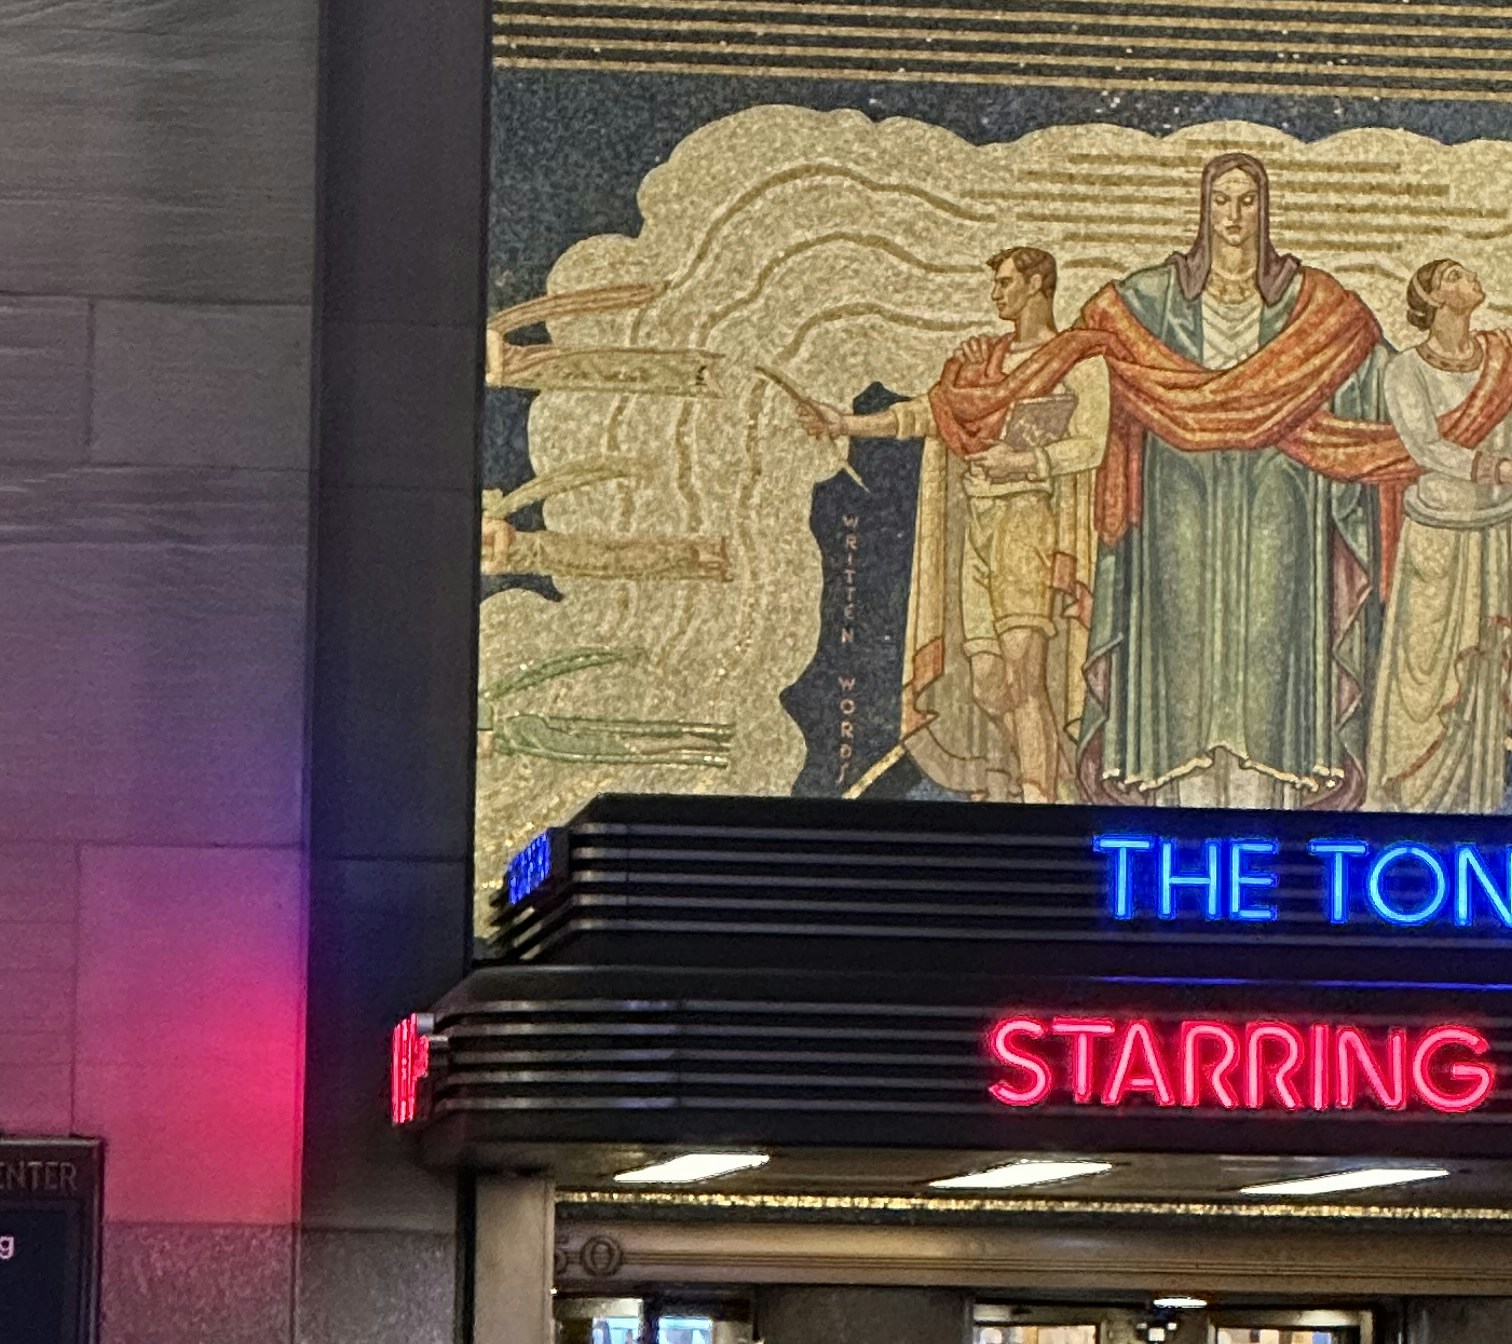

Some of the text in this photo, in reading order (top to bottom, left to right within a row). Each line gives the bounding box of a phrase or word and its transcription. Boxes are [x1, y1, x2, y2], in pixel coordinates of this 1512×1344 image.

[838, 514, 860, 785] WRITTEN WORDS
[1093, 834, 1278, 922] THE
[985, 1015, 1495, 1112] STARRING
[0, 1161, 78, 1192] NTER
